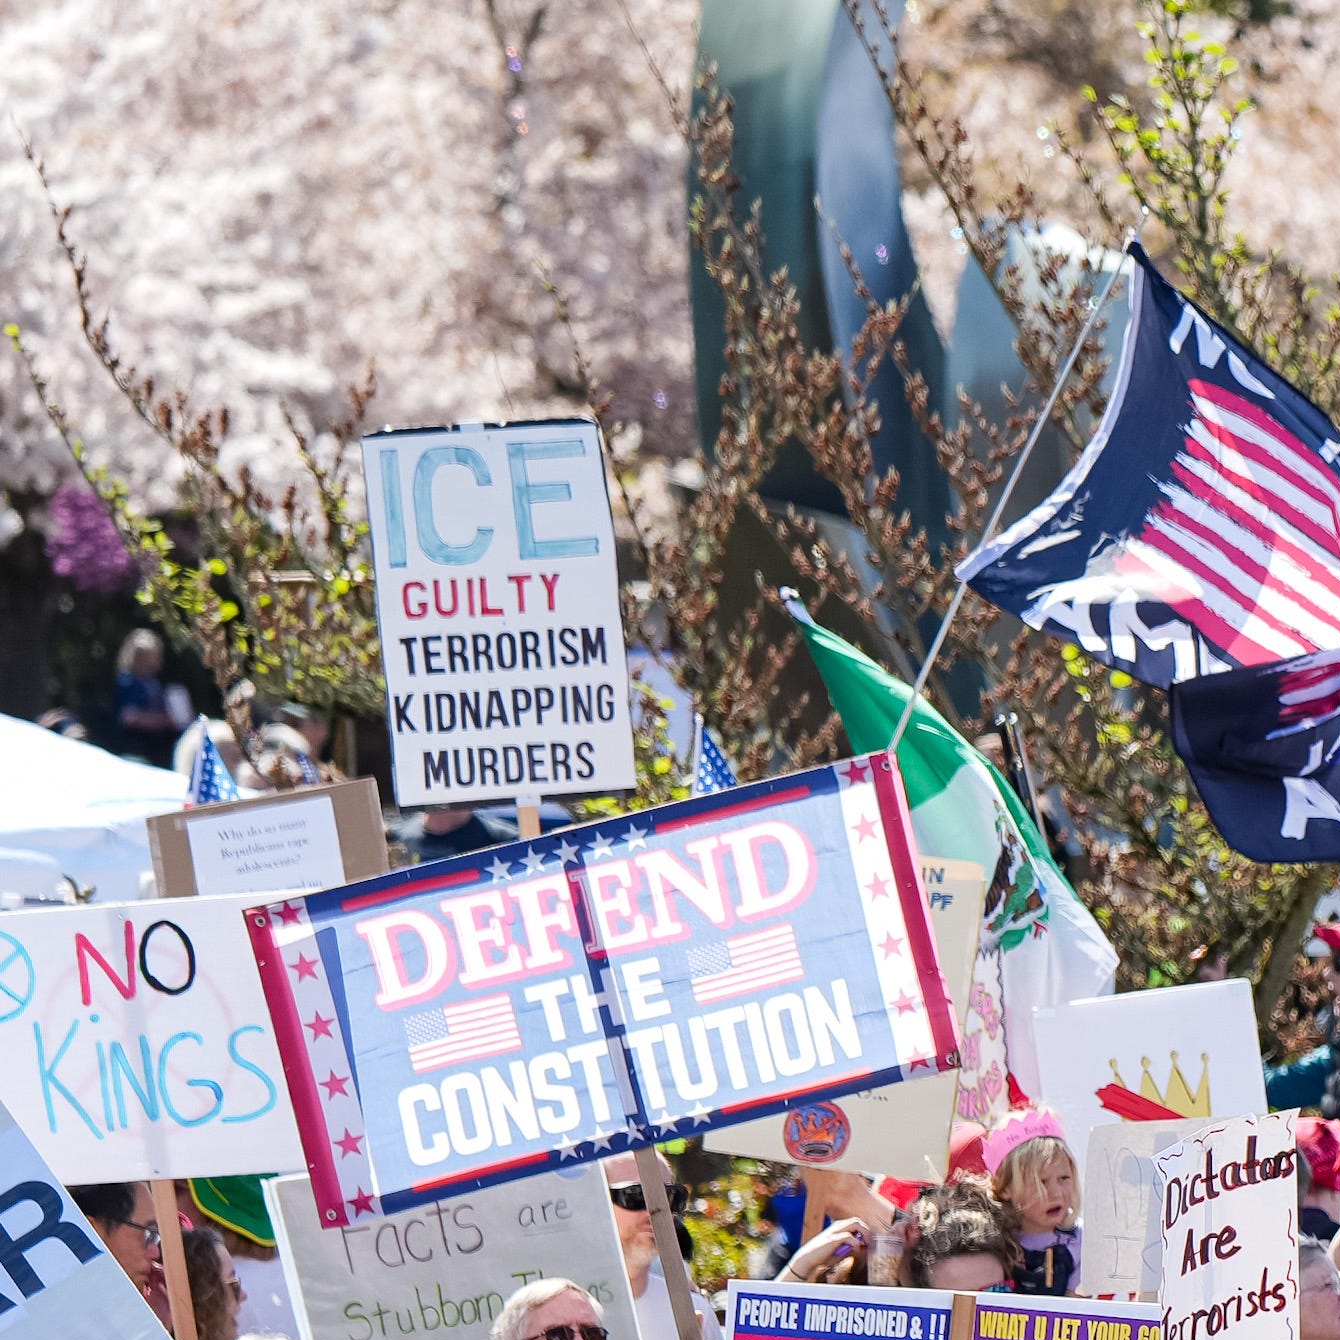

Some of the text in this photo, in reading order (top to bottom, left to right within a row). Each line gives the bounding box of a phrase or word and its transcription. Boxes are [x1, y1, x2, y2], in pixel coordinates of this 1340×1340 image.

[379, 438, 600, 569] ICE
[402, 573, 561, 620] GUILTY
[399, 626, 608, 677] TERRORISM
[396, 683, 616, 736] KIDNAPPING
[423, 743, 595, 790] MURDERS
[221, 841, 285, 859] Republicans
[356, 820, 813, 1010] DEFEND
[74, 919, 196, 1006] NO
[523, 957, 672, 1043] THE
[398, 979, 864, 1168] CONSTITUTION
[1181, 1224, 1242, 1277] Are
[739, 1298, 908, 1339] PEOPLE IMPRISONED
[979, 1310, 1028, 1340] WHAT
